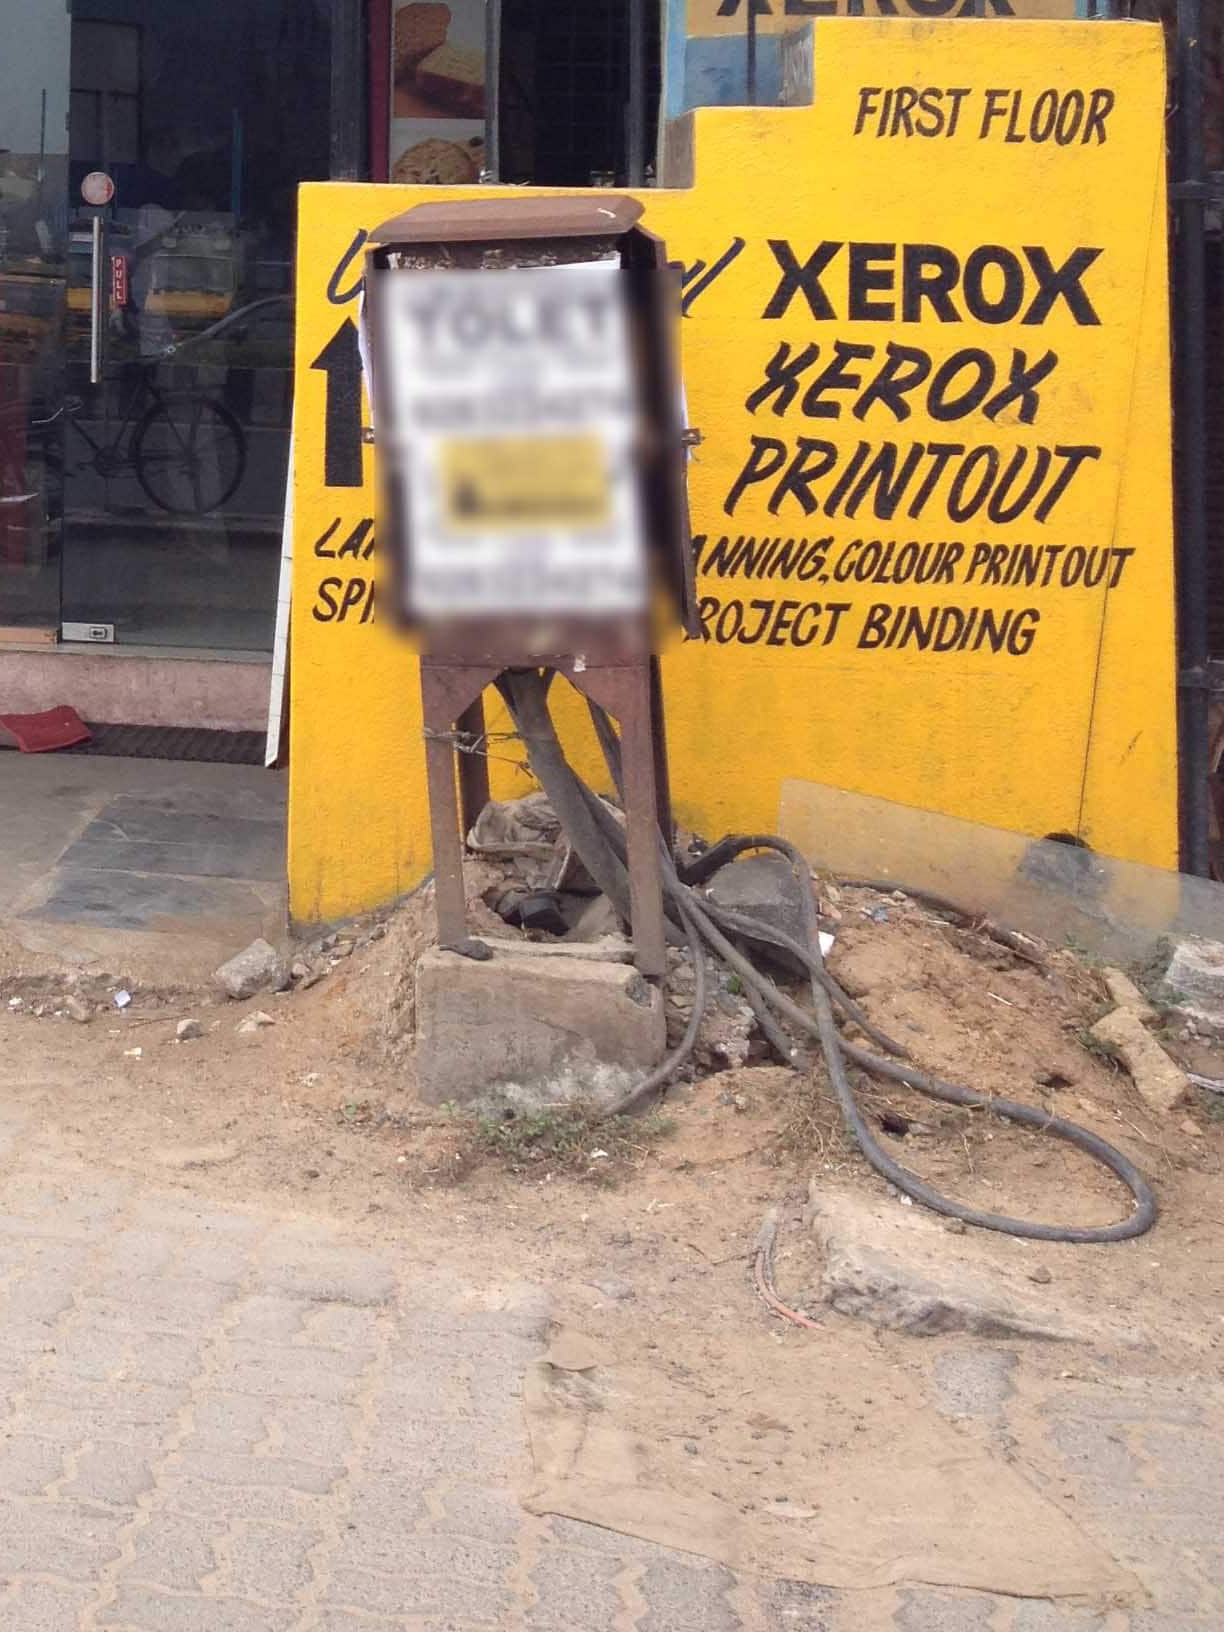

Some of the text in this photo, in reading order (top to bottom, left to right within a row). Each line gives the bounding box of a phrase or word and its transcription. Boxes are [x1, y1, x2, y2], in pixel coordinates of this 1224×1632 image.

[853, 85, 1116, 147] FIRST FLOOR
[761, 238, 1106, 327] XEROX
[744, 339, 1060, 426] XEROX
[722, 434, 1103, 525] PRINTOUT
[856, 605, 1040, 656] BINDING
